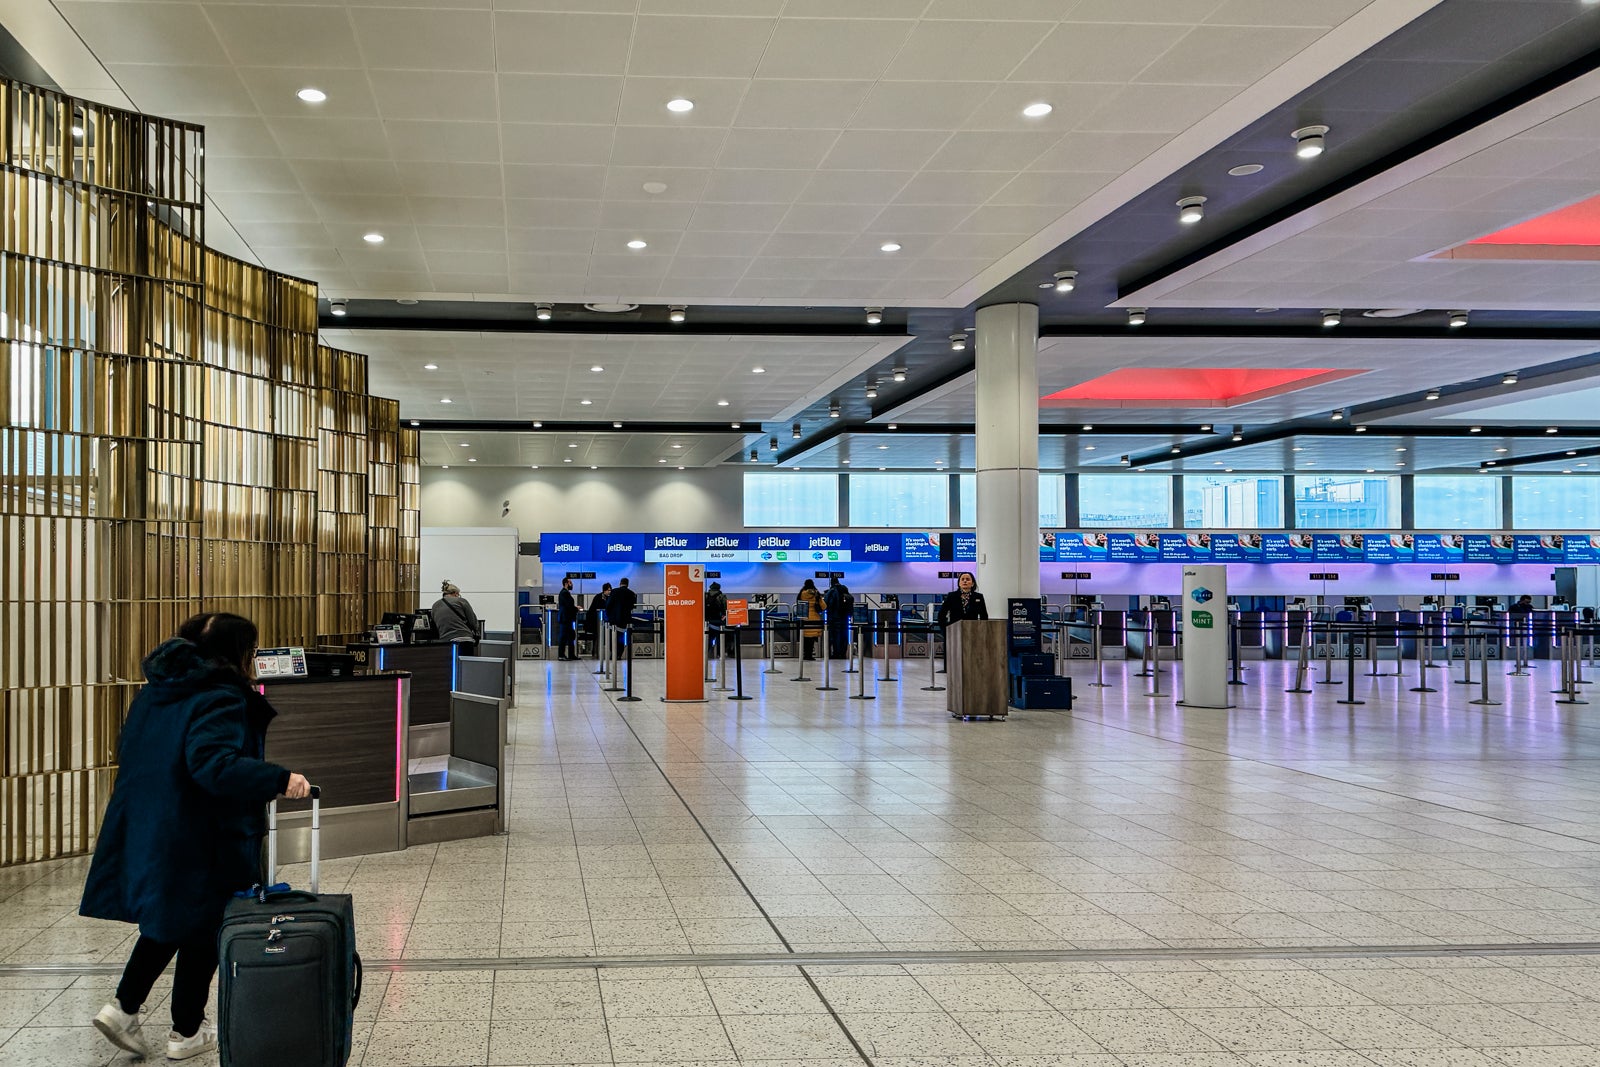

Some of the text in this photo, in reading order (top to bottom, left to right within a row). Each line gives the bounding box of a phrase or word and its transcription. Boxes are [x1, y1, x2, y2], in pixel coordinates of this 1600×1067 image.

[654, 536, 688, 549] jetBlue
[706, 536, 739, 549] jetBlue
[758, 536, 791, 549] jetBlue
[808, 536, 842, 549] jetBlue
[554, 544, 580, 554] jetBlue
[607, 544, 632, 554] jetBlue
[864, 544, 890, 553] jetBlue
[694, 568, 700, 578] 2
